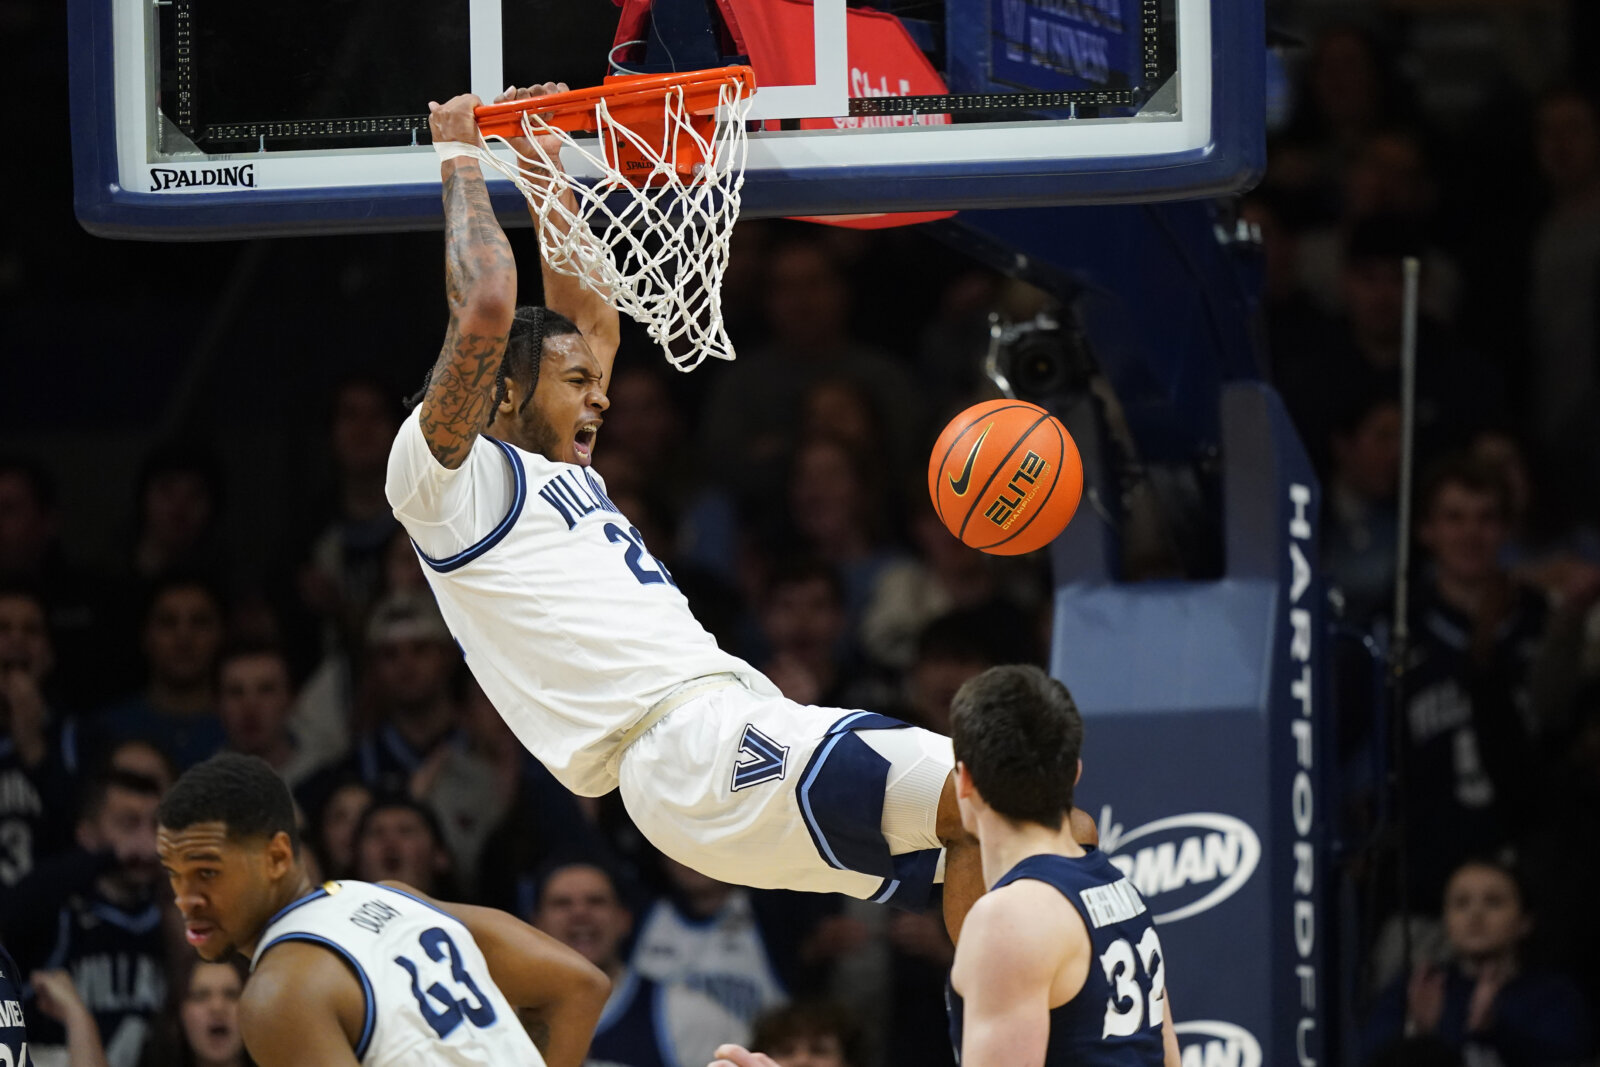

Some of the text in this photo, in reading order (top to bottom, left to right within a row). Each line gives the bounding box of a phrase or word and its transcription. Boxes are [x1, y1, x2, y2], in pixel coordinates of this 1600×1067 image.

[150, 163, 254, 192] SPALDING
[626, 161, 656, 171] SPALD
[984, 450, 1047, 527] ELITE
[731, 723, 790, 792] V
[393, 927, 497, 1039] 43
[1099, 926, 1165, 1040] 32
